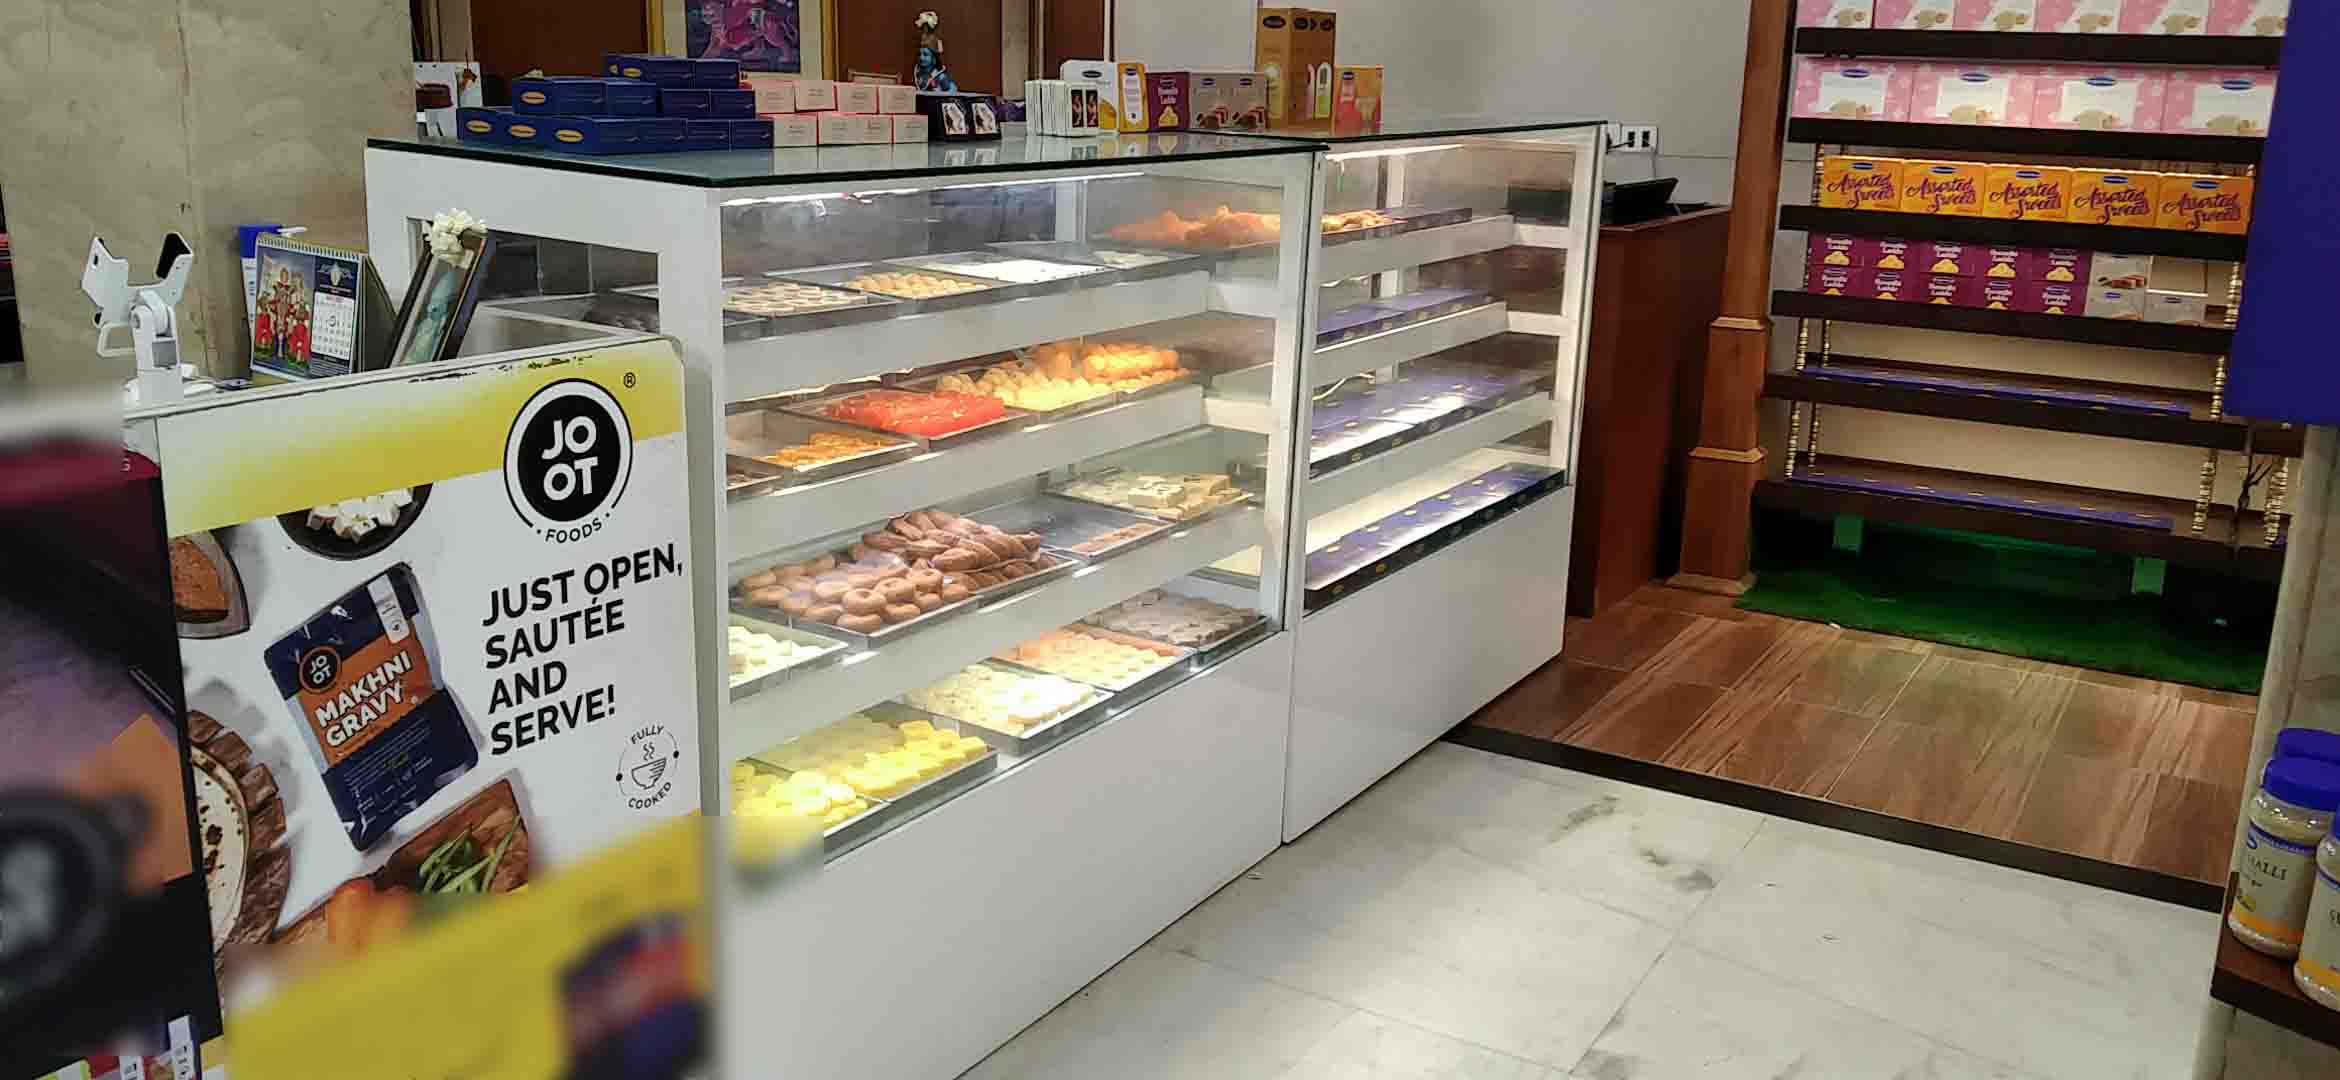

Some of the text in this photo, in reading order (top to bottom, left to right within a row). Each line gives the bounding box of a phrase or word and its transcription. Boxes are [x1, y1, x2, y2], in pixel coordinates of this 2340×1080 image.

[545, 517, 603, 544] FOODS
[482, 543, 683, 627] JUST OPEN,
[485, 597, 626, 669] SAUTÉE
[314, 650, 414, 729] MAKHNI
[326, 679, 404, 748] GRAVY
[488, 660, 568, 716] AND
[491, 684, 616, 756] SERVE!
[631, 724, 664, 745] FULLY
[628, 781, 672, 810] COOKED
